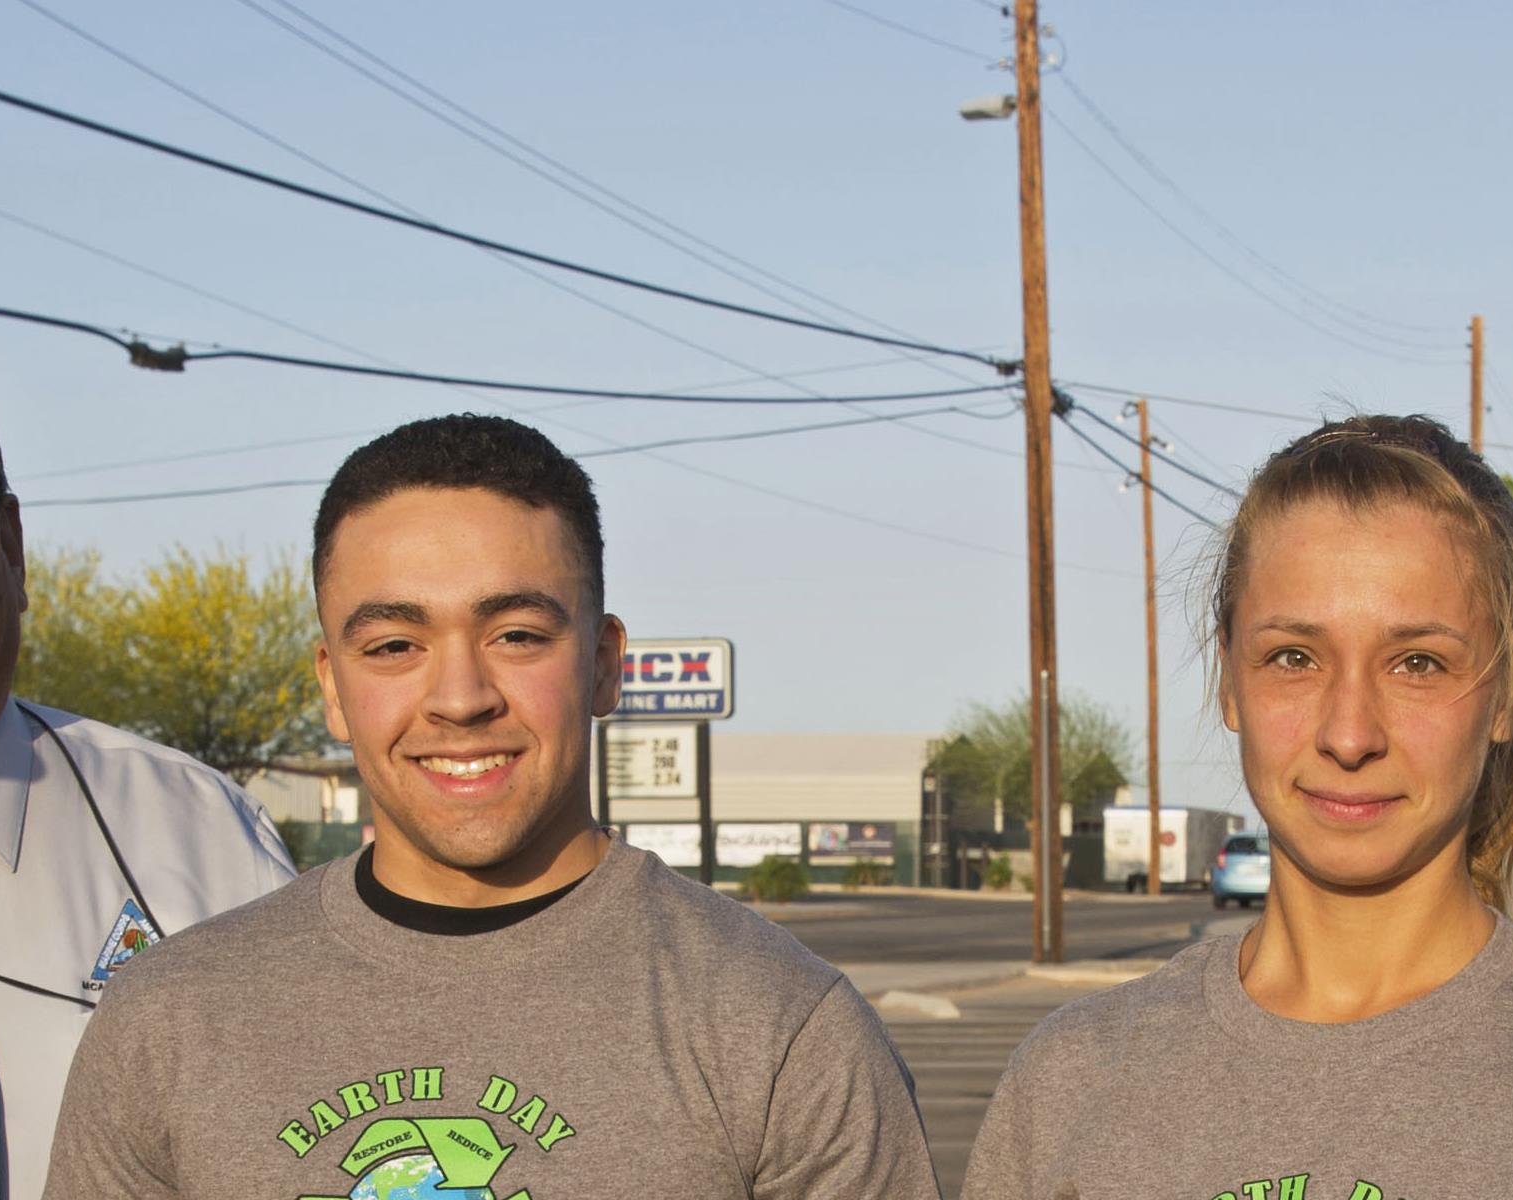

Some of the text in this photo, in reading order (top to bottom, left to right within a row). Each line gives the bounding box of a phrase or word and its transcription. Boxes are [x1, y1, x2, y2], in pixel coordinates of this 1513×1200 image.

[663, 693, 719, 710] MART
[82, 981, 104, 991] MCA
[277, 1067, 576, 1158] EARTH DAY
[351, 1131, 413, 1162] RESTORE
[446, 1129, 494, 1161] REDUCE
